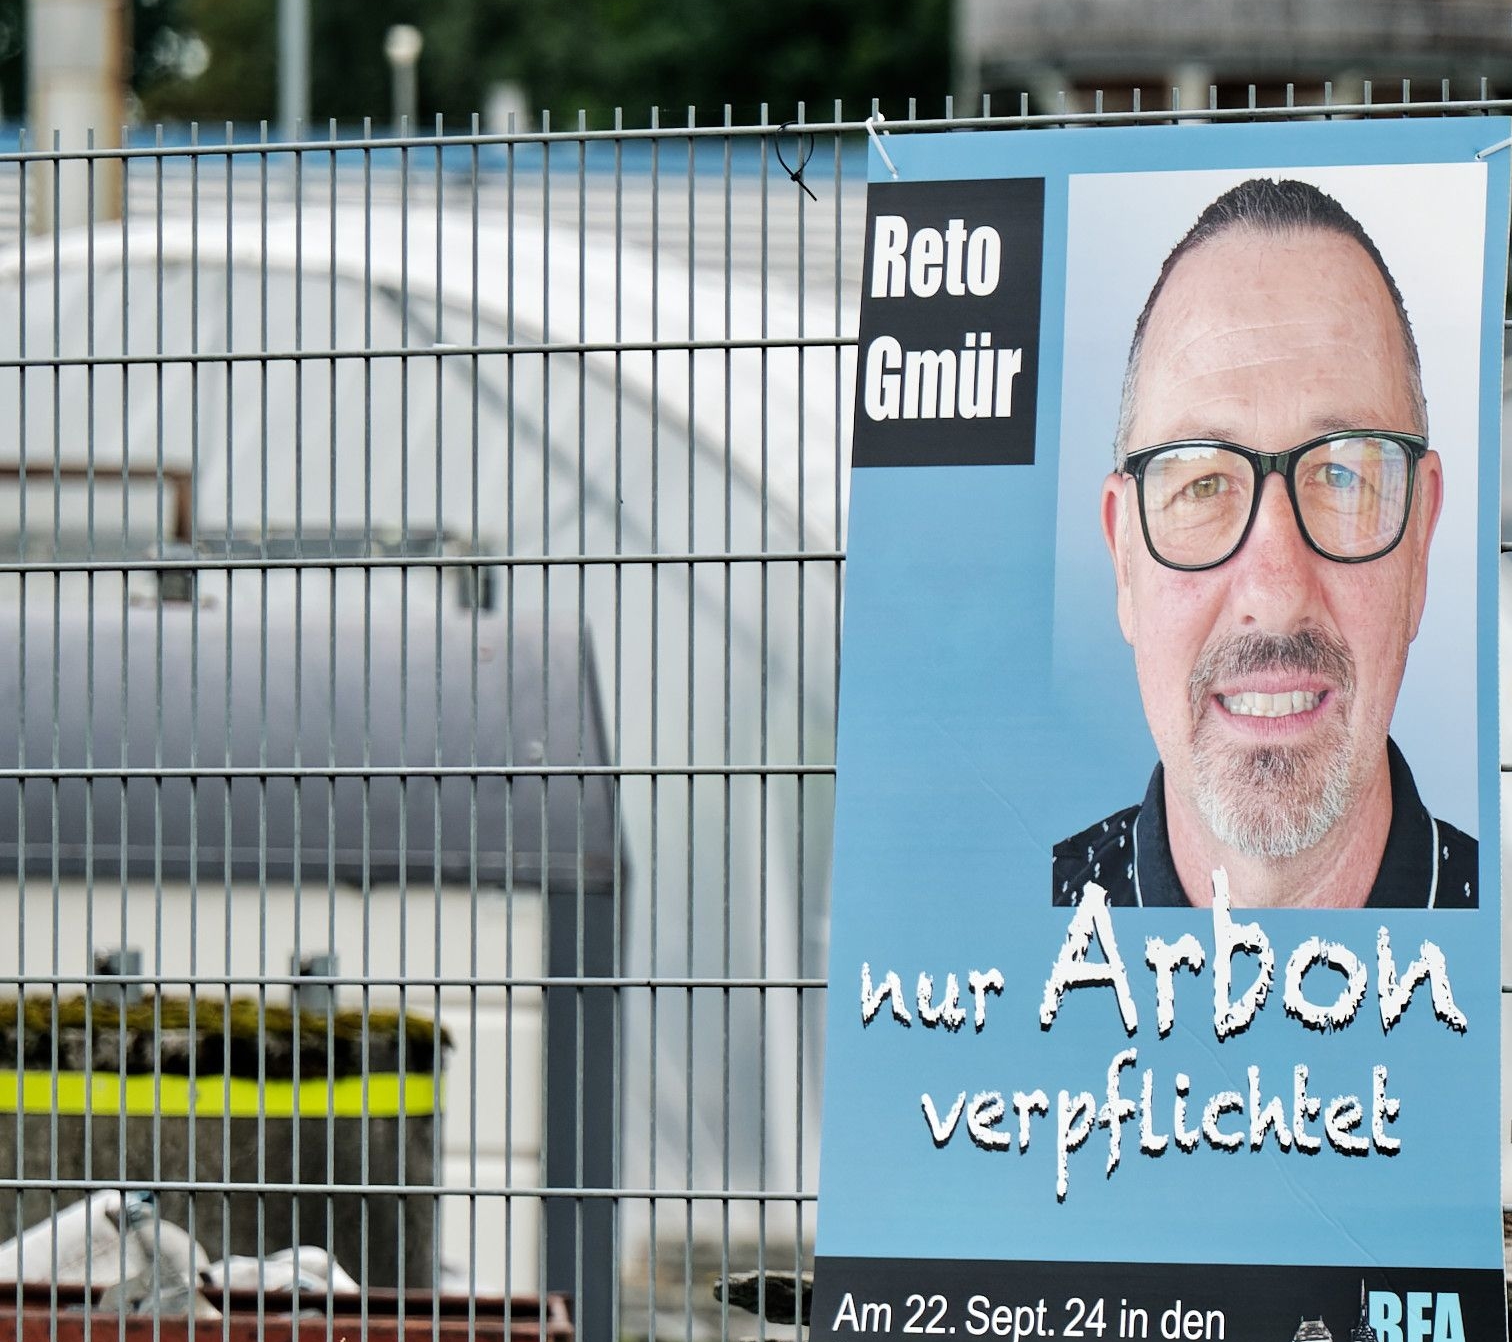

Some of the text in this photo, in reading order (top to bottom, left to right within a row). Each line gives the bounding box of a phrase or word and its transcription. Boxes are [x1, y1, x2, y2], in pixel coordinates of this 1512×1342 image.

[871, 214, 1001, 299] Reto
[865, 333, 1024, 422] Gmür
[860, 867, 1469, 1035] nur Arbon
[919, 1049, 1402, 1201] verpflichtet
[832, 1292, 893, 1333] Am
[903, 1294, 955, 1334] 22.
[1063, 1298, 1106, 1336] 24
[1119, 1298, 1150, 1338] in
[1160, 1301, 1225, 1340] den
